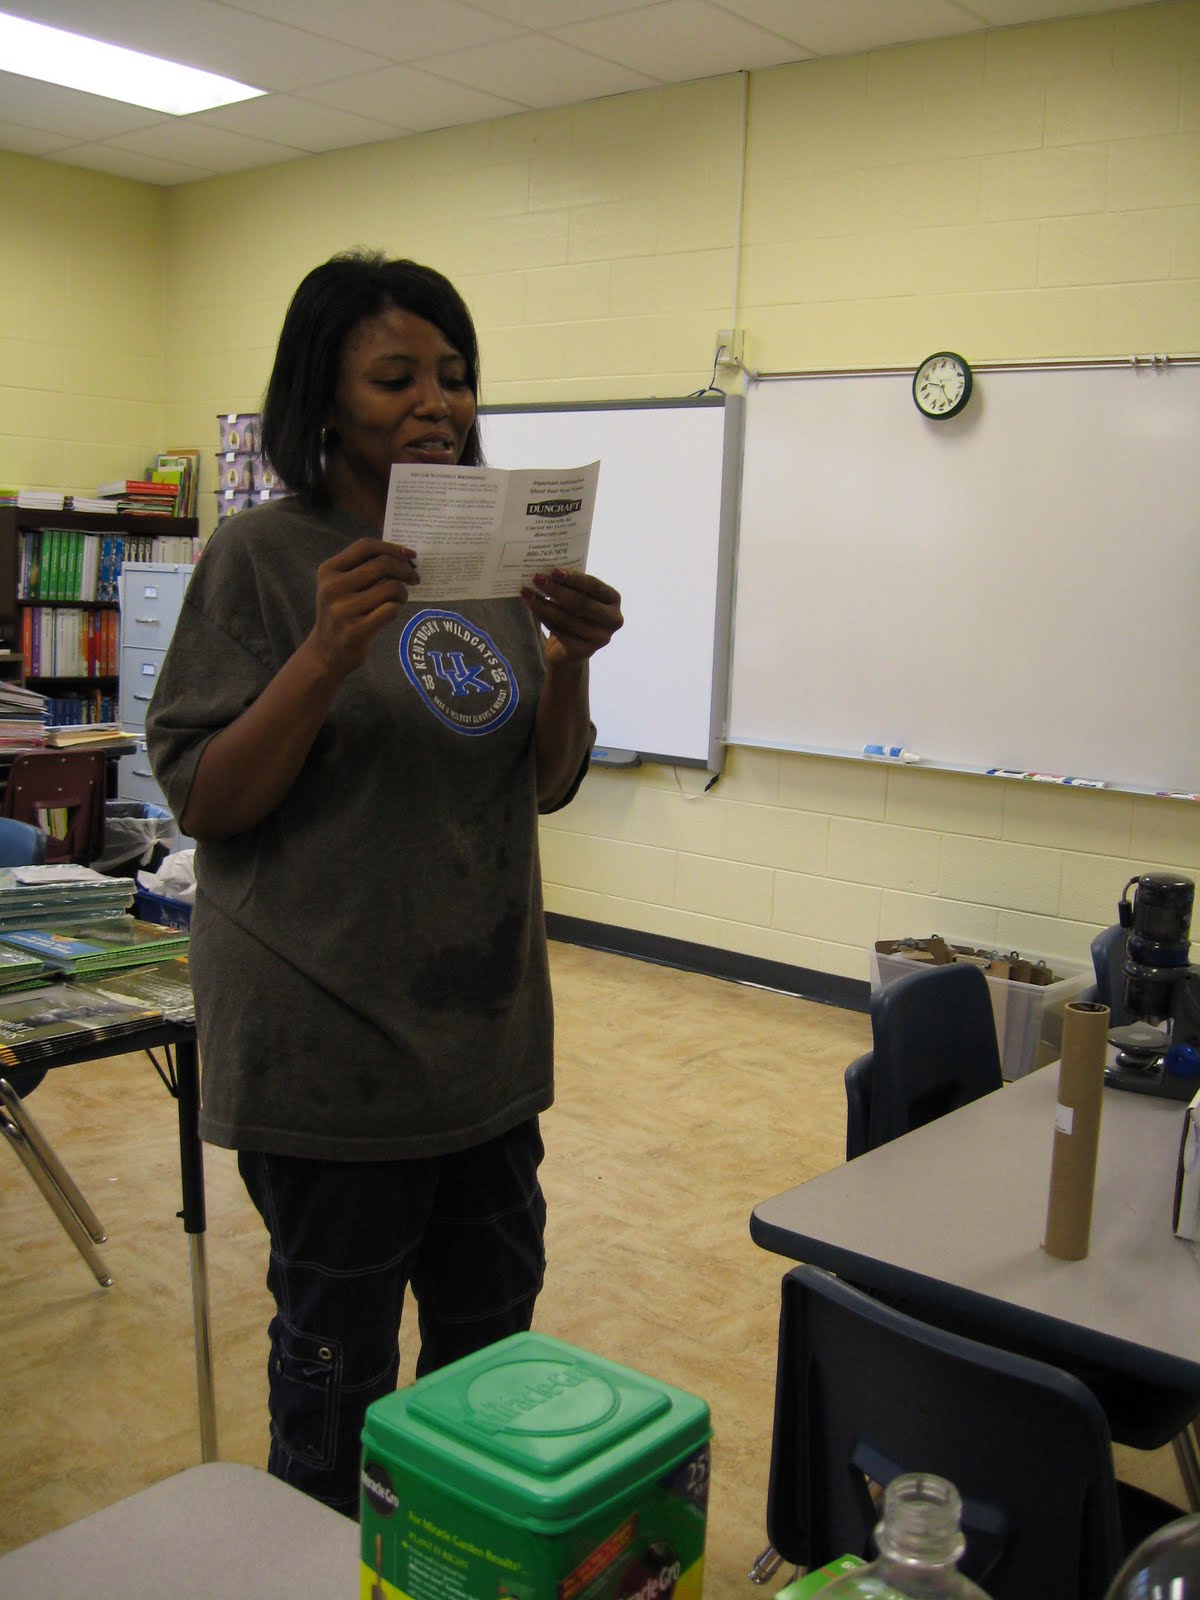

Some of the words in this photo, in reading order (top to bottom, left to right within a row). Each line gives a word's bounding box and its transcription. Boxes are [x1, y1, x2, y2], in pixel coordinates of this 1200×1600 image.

[529, 502, 580, 513] DUNCRAFT
[412, 620, 440, 670] KENTUCKY
[443, 620, 499, 665] WILDCATS
[421, 674, 436, 690] 18
[427, 651, 495, 697] UK
[491, 668, 508, 683] 65
